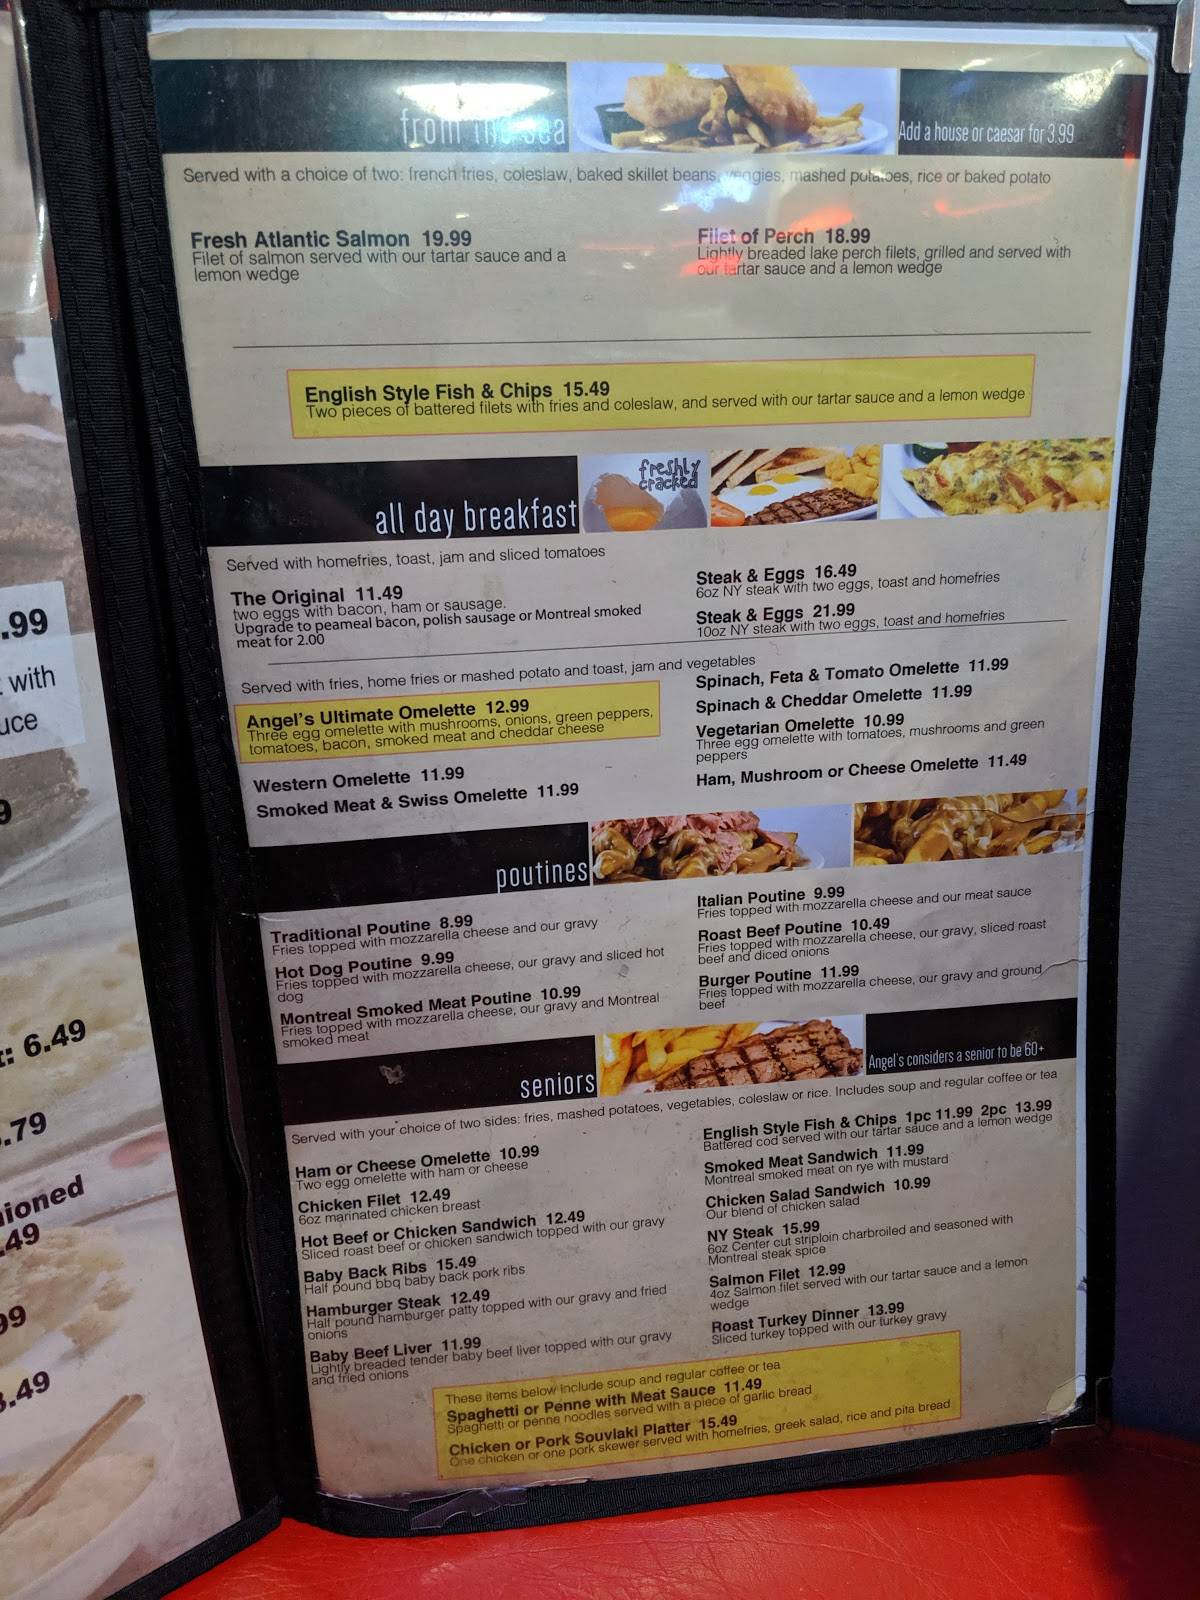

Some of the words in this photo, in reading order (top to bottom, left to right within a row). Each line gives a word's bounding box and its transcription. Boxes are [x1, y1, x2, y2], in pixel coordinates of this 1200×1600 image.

[400, 108, 460, 144] from
[898, 121, 920, 141] Add
[924, 128, 931, 141] a
[934, 121, 968, 142] house
[972, 128, 984, 142] or
[986, 129, 1024, 143] caesar
[1028, 123, 1044, 143] for
[1048, 124, 1074, 144] 3.99
[190, 231, 247, 248] Fresh
[254, 231, 330, 247] Atlantic
[335, 230, 409, 247] Salmon
[422, 230, 472, 246] 19.99
[698, 228, 735, 243] Filet
[740, 228, 759, 243] of
[764, 228, 814, 243] Perch
[825, 228, 870, 243] 18.99
[194, 267, 241, 281] lemon
[245, 266, 299, 284] wedge
[305, 385, 376, 407] English
[382, 384, 430, 405] Style
[435, 383, 474, 400] Fish
[481, 383, 494, 399] &
[500, 382, 552, 403] Chips
[563, 380, 610, 397] 15.49
[638, 458, 701, 479] freshly
[638, 472, 698, 491] cracked
[375, 502, 403, 534] all
[414, 501, 454, 539] day
[464, 496, 578, 531] breakfast
[226, 557, 278, 571] Served
[282, 556, 312, 568] with
[316, 553, 392, 569] homefries,
[396, 551, 434, 566] toast,
[439, 550, 464, 566] jam
[468, 549, 495, 561] and
[499, 547, 540, 560] sliced
[544, 545, 605, 558] tomatoes
[695, 586, 719, 598] 6oz
[723, 584, 742, 597] NY
[745, 582, 780, 596] steak
[782, 581, 808, 594] with
[812, 579, 834, 592] two
[837, 580, 873, 594] eggs,
[878, 576, 908, 589] toast
[911, 574, 936, 587] and
[939, 571, 1000, 586] homefries
[696, 568, 741, 585] Steak
[746, 568, 758, 582] &
[764, 565, 804, 585] Eggs
[815, 562, 856, 579] 16.49
[230, 590, 266, 606] The
[271, 586, 344, 609] Original
[355, 584, 403, 600] 11.49
[8, 665, 56, 693] with
[696, 671, 764, 692] Spinach,
[770, 669, 803, 684] Feta
[808, 668, 819, 682] &
[827, 665, 884, 681] Tomato
[888, 661, 959, 678] Omelette
[968, 658, 1008, 674] 11.99
[320, 706, 393, 725] Ultimate
[398, 702, 476, 720] Omelette
[485, 699, 529, 715] 12.99
[696, 720, 779, 742] Vegetarian
[784, 716, 854, 733] Omelette
[864, 712, 904, 728] 10.99
[252, 774, 327, 793] Western
[332, 769, 410, 788] Omelette
[420, 766, 464, 782] 11.99
[496, 860, 587, 895] poutines
[697, 892, 742, 907] Italian
[748, 888, 805, 904] Poutine
[813, 885, 844, 899] 9.99
[269, 923, 361, 944] Traditional
[366, 917, 430, 936] Poutine
[439, 914, 473, 930] 8.99
[698, 927, 741, 942] Roast
[746, 924, 780, 939] Beef
[784, 920, 842, 936] Poutine
[851, 917, 890, 932] 10.49
[698, 971, 750, 991] Burger
[754, 967, 811, 984] Poutine
[820, 964, 859, 979] 11.99
[280, 1006, 351, 1025] Montreal
[356, 1000, 423, 1018] Smoked
[428, 996, 466, 1012] Meat
[471, 990, 532, 1008] Poutine
[540, 986, 581, 1002] 10.99
[24, 1019, 86, 1057] 6.49
[906, 1049, 954, 1066] considers
[956, 1051, 962, 1063] a
[964, 1046, 994, 1062] senior
[997, 1046, 1007, 1060] to
[1009, 1044, 1022, 1059] be
[1024, 1042, 1044, 1058] 60+
[521, 1072, 594, 1098] seniors
[0, 1112, 47, 1147] .79
[295, 1164, 331, 1179] Ham
[335, 1164, 352, 1175] or
[356, 1156, 416, 1174] Cheese
[420, 1150, 490, 1168] Omelette
[499, 1145, 539, 1161] 10.99
[0, 1174, 84, 1227] ioned
[297, 1196, 362, 1214] Chicken
[366, 1193, 401, 1208] Filet
[410, 1188, 450, 1204] 12.49
[705, 1208, 728, 1219] Our
[730, 1204, 764, 1217] blend
[766, 1203, 777, 1214] of
[781, 1199, 826, 1213] chicken
[828, 1196, 860, 1208] salad
[707, 1229, 727, 1243] NY
[732, 1224, 773, 1240] Steak
[782, 1220, 820, 1236] 15.99
[304, 1282, 328, 1294] Half
[332, 1278, 371, 1295] pound
[375, 1275, 400, 1291] bbq
[404, 1272, 435, 1288] baby
[438, 1269, 469, 1282] back
[472, 1266, 500, 1282] pork
[502, 1263, 525, 1276] ribs
[709, 1271, 764, 1288] Salmon
[768, 1268, 800, 1282] Filet
[808, 1263, 845, 1279] 12.99
[711, 1317, 754, 1333] Roast
[757, 1312, 807, 1332] Turkey
[811, 1306, 859, 1323] Dinner
[867, 1302, 904, 1318] 13.99
[0, 1371, 50, 1413] .49
[446, 1402, 518, 1426] Spaghetti
[523, 1403, 539, 1415] or
[544, 1395, 591, 1412] Penne
[594, 1392, 626, 1407] with
[630, 1388, 666, 1404] Meat
[670, 1382, 716, 1400] Sauce
[724, 1378, 762, 1394] 11.49
[449, 1438, 510, 1456] Chicken
[514, 1439, 531, 1449] or
[535, 1432, 570, 1447] Pork
[574, 1426, 638, 1444] Souvlaki
[643, 1420, 691, 1437] Platter
[698, 1416, 737, 1431] 15.49
